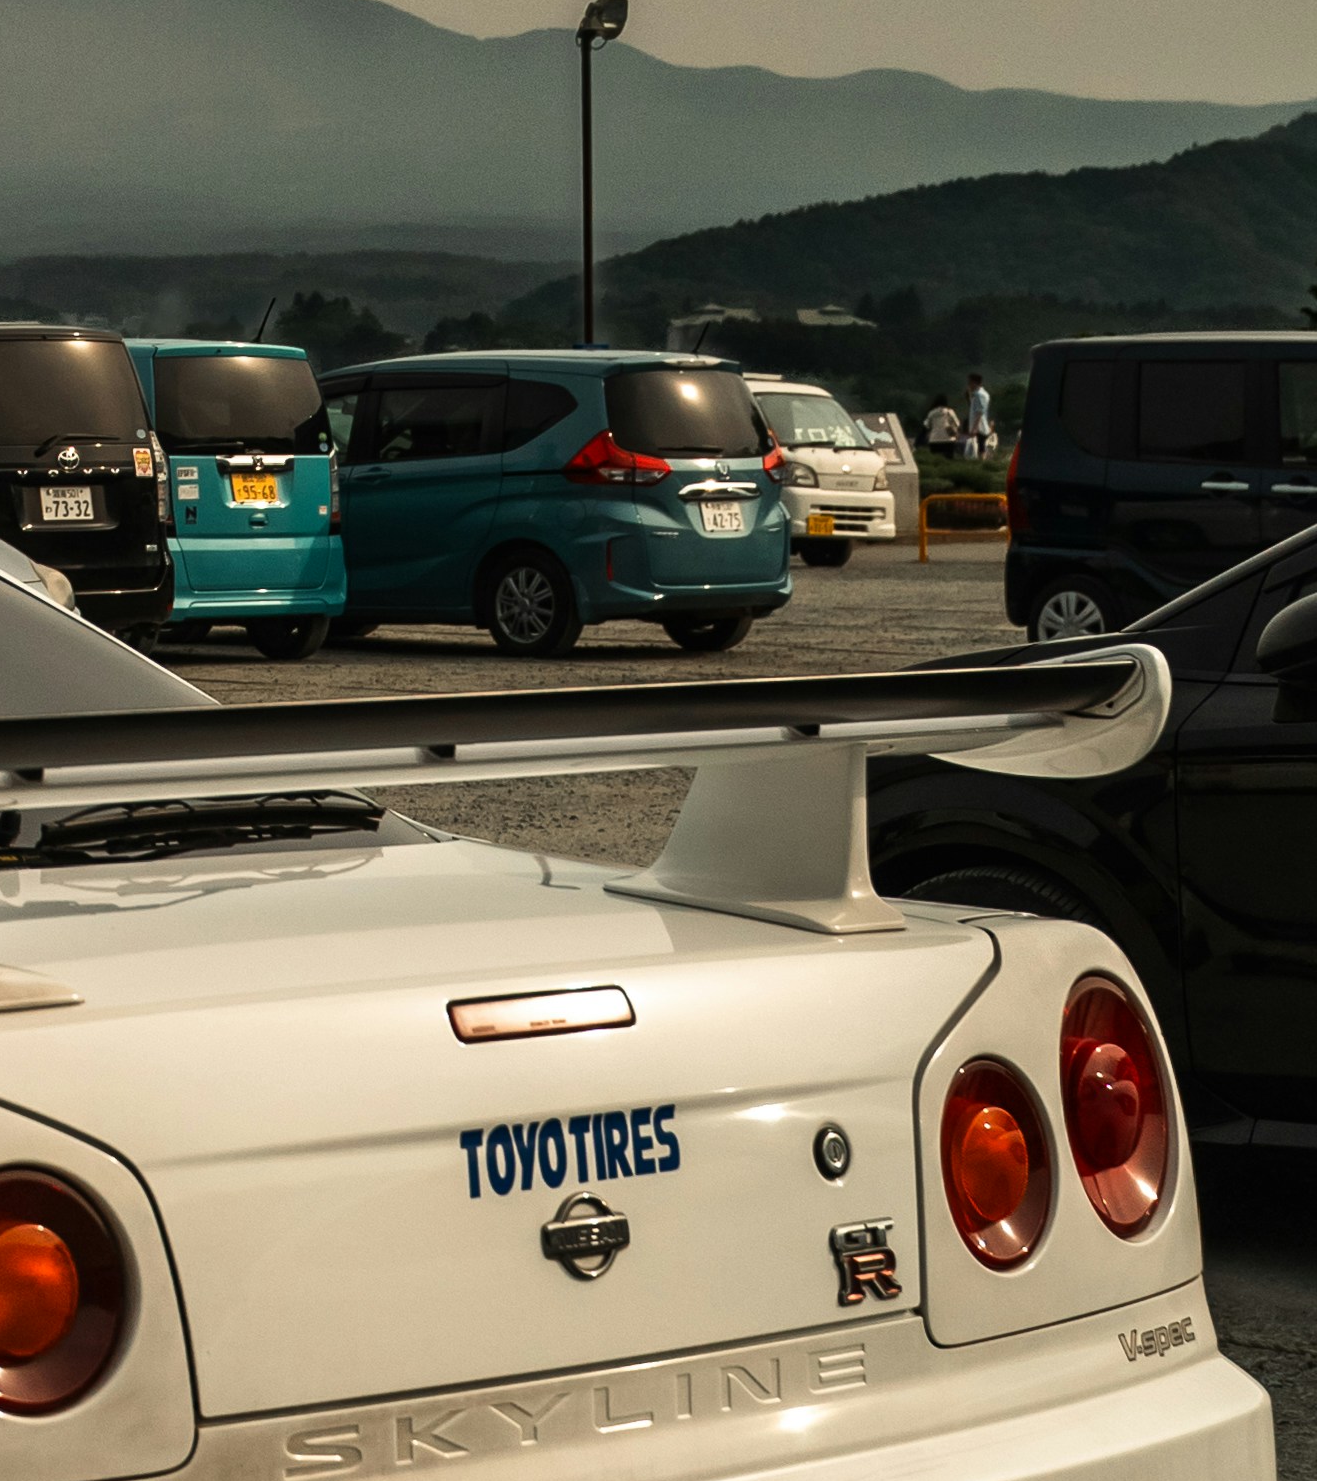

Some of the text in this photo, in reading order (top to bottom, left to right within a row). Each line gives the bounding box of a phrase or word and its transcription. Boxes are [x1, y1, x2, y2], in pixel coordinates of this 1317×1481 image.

[53, 500, 91, 517] 73-32
[830, 1217, 895, 1252] GT
[838, 1247, 902, 1306] R
[283, 1343, 866, 1481] SKYLINE
